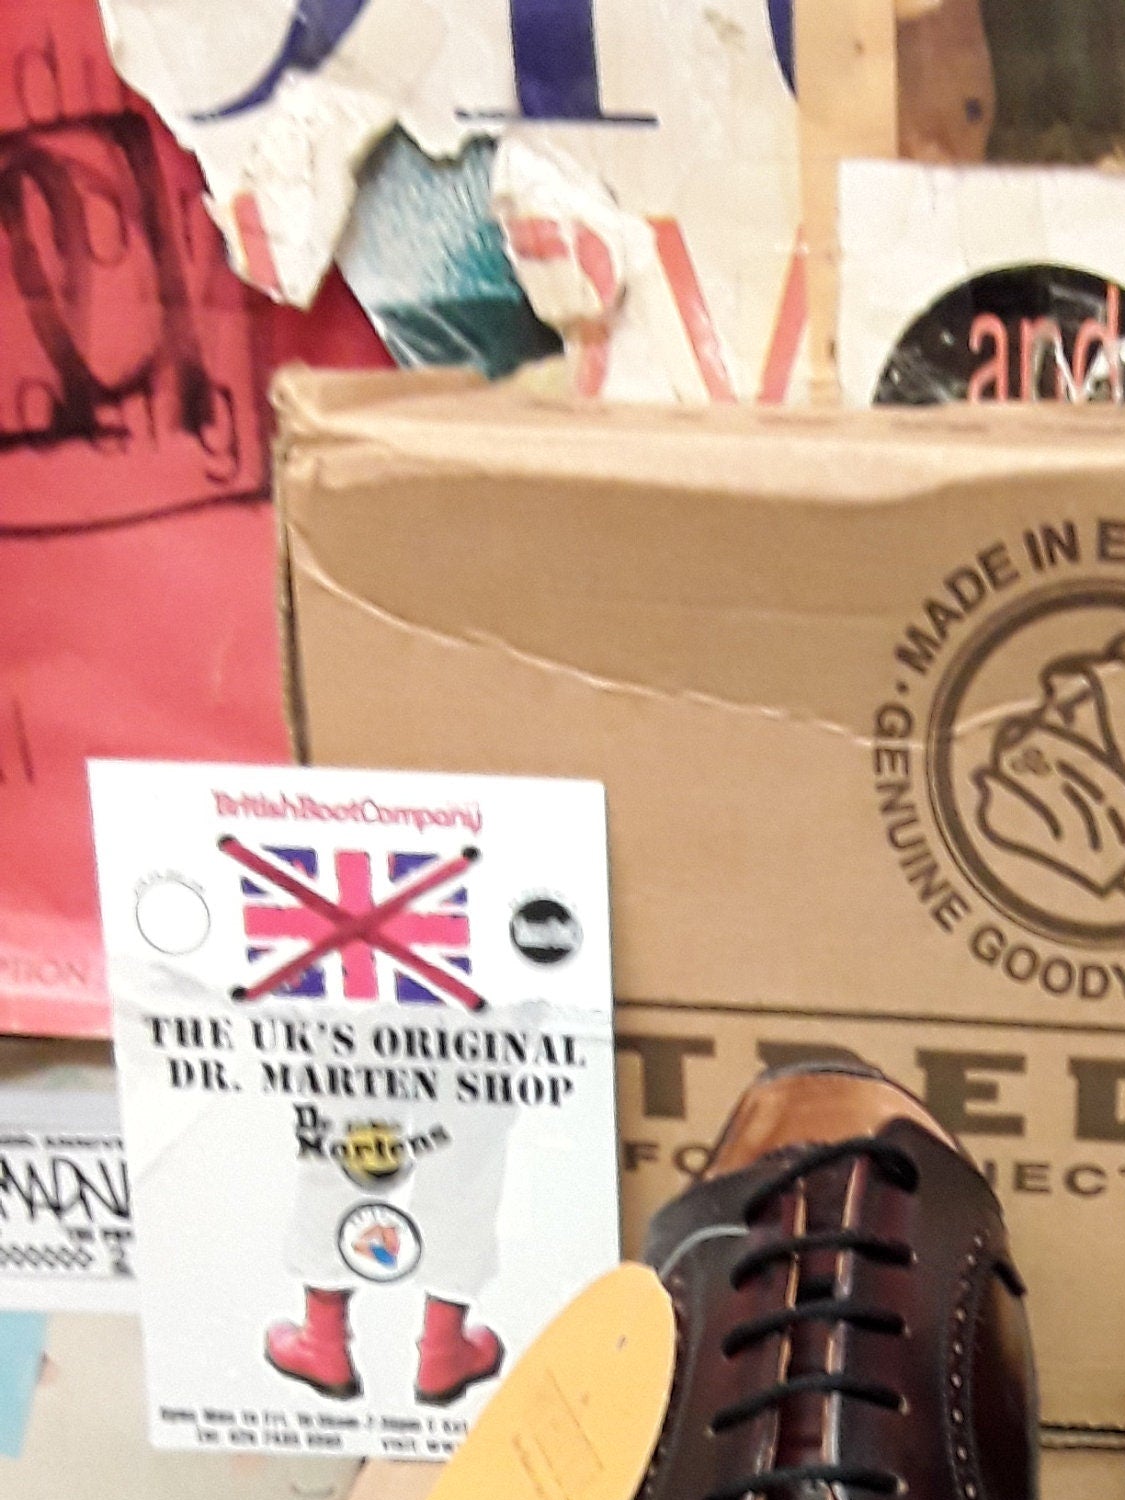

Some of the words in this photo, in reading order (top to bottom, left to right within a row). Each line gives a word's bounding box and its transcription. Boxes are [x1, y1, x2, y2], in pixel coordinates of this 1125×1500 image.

[895, 542, 1020, 675] MADE
[1023, 520, 1080, 571] IN
[873, 703, 972, 932] GENUINE
[144, 1014, 234, 1050] THE
[248, 1019, 358, 1058] UK'S
[372, 1026, 587, 1068] ORIGINAL
[167, 1057, 242, 1092] DR.
[260, 1061, 441, 1103] MARTEN
[456, 1071, 576, 1108] SHOP
